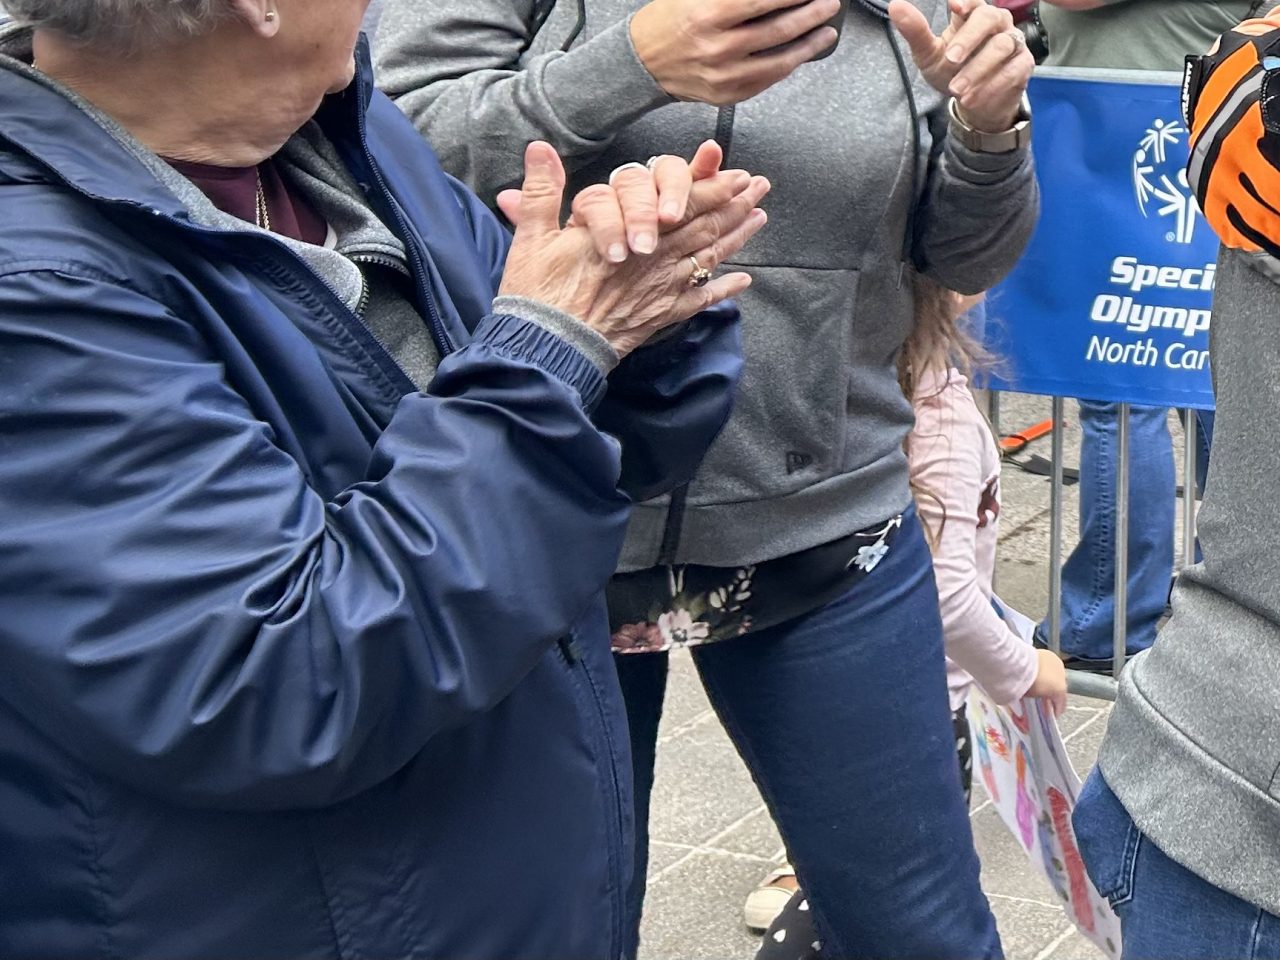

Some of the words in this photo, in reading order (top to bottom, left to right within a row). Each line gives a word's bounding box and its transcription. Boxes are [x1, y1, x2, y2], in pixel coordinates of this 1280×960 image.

[1110, 256, 1217, 291] Speci
[1091, 294, 1211, 336] Olymp
[1086, 335, 1158, 367] North
[1164, 342, 1210, 370] Car
